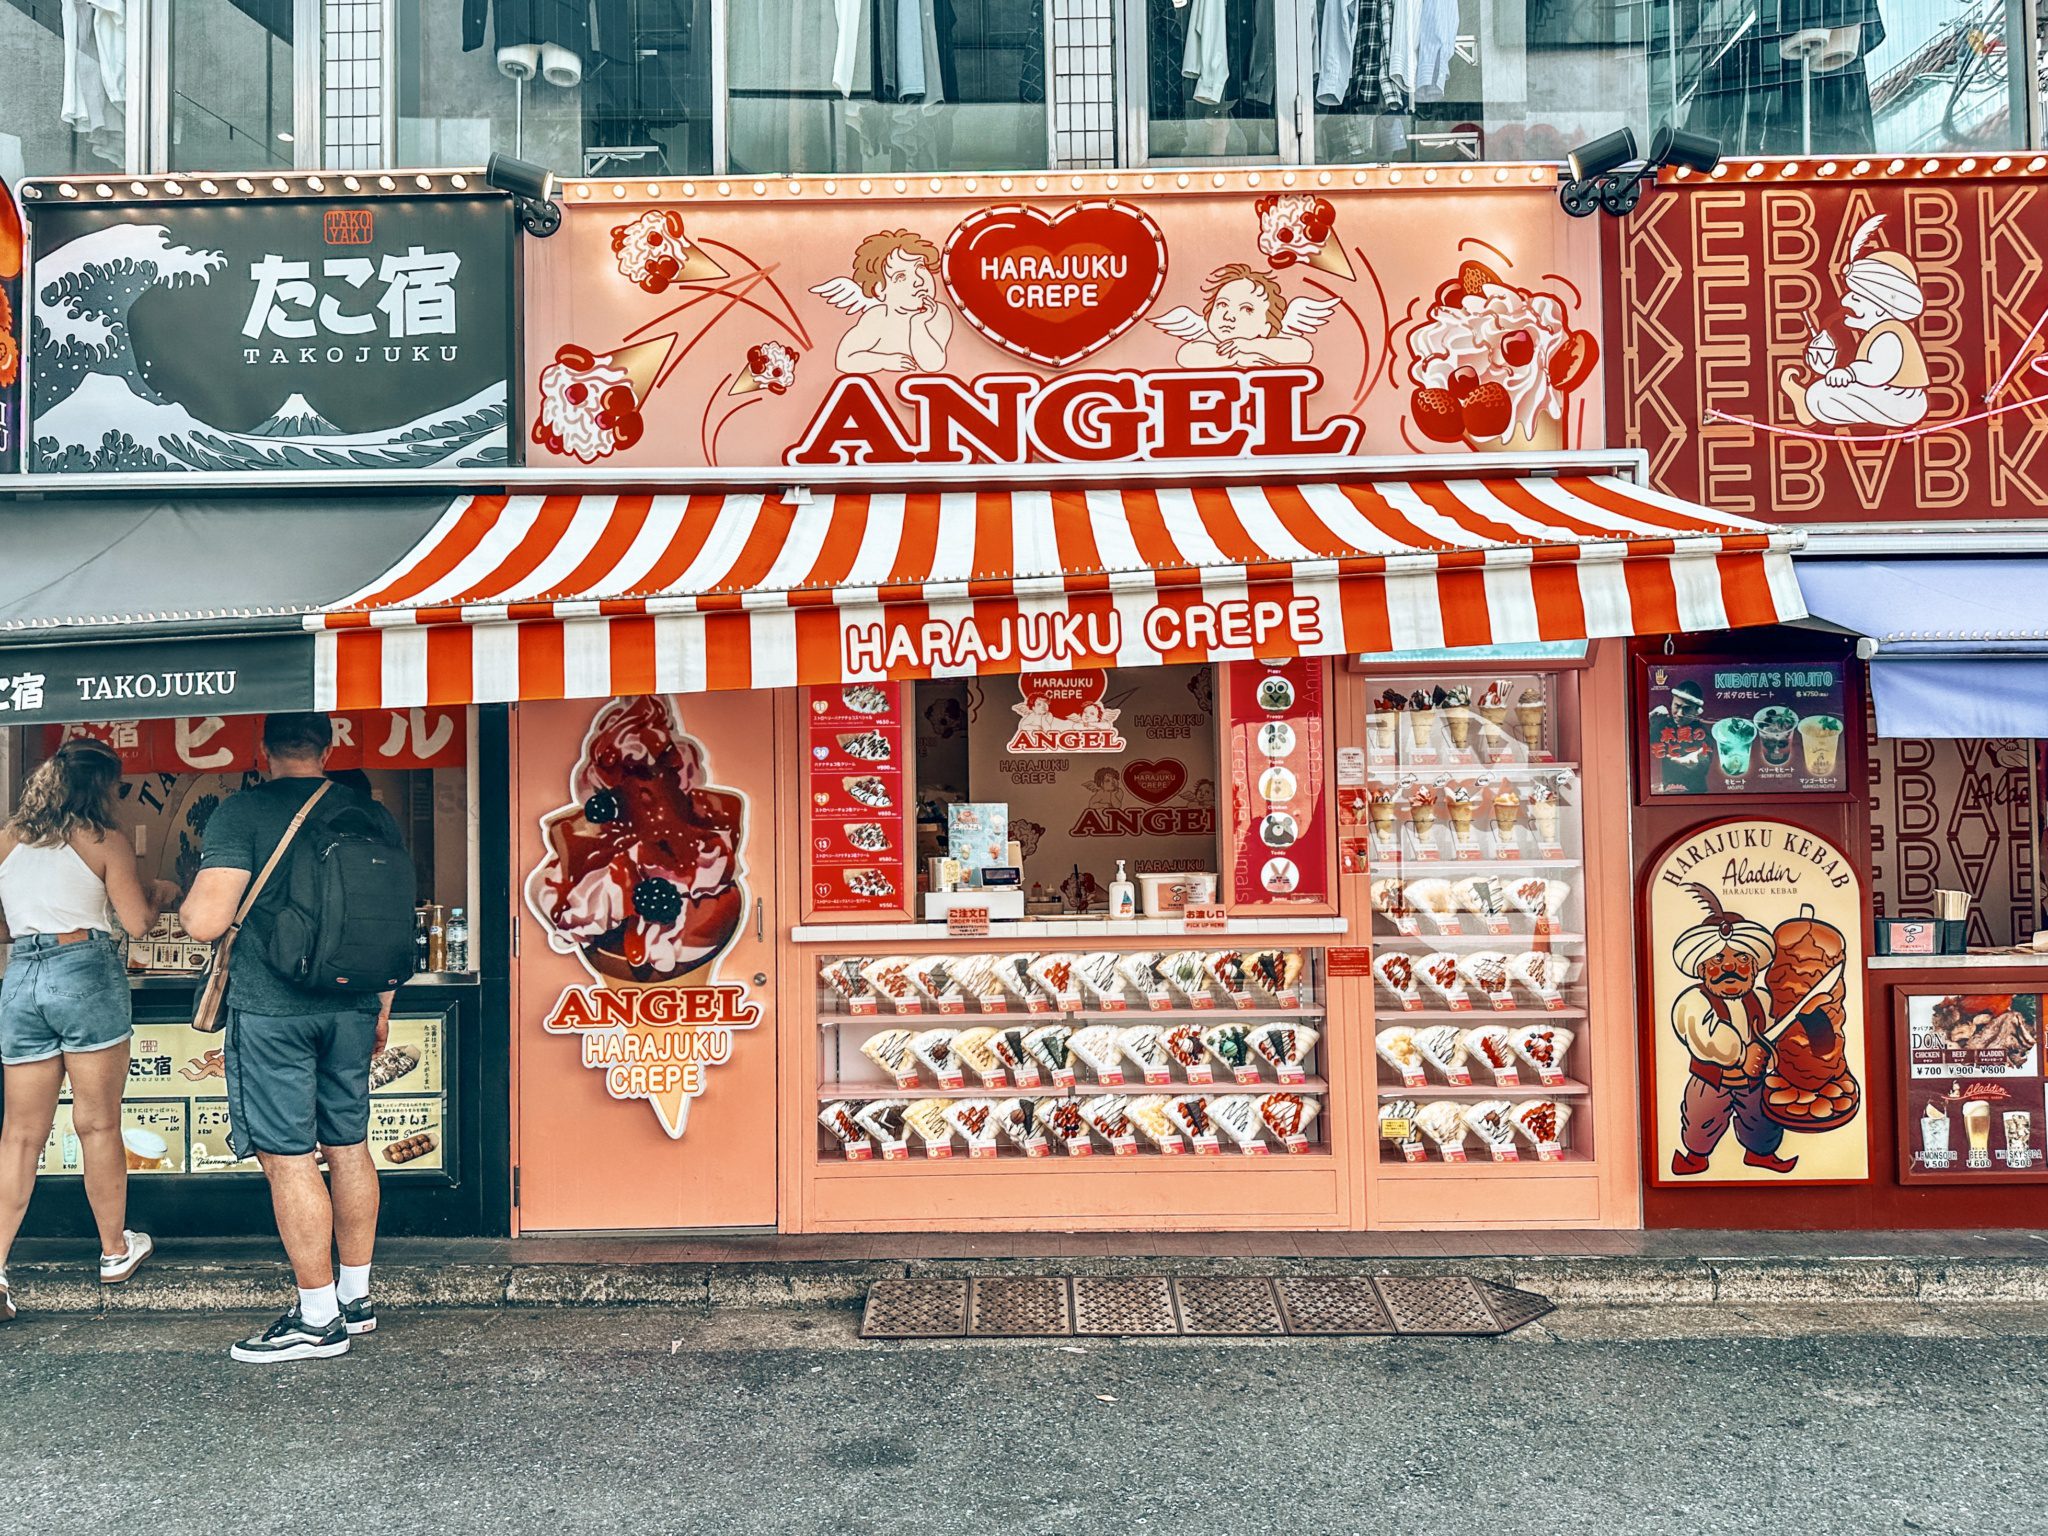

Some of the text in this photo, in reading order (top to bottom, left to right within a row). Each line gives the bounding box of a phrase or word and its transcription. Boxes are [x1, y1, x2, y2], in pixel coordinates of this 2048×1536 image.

[326, 211, 370, 229] TAKO
[328, 227, 370, 243] YAKI
[980, 254, 1128, 281] HARAJUKU
[242, 245, 462, 340] たこ宿
[1006, 282, 1099, 308] CREPE
[243, 345, 459, 364] TAKOJUKU
[784, 368, 1364, 465] ANGEL
[845, 596, 1323, 674] HARAJUKU CREPE
[77, 671, 237, 701] TAKOJUKU
[1033, 677, 1093, 688] HARAJUKU
[1714, 671, 1833, 689] KUBOTA'S MOJITO
[1046, 689, 1083, 700] CREPE
[1134, 714, 1205, 728] HARAJUKU
[1009, 731, 1124, 751] ANGEL
[1146, 727, 1191, 739] CREPE
[1000, 759, 1069, 772] HARAJUKU
[1011, 771, 1057, 784] CREPE
[1134, 774, 1176, 782] HARAJUKU
[1141, 781, 1168, 789] CREPE
[1134, 859, 1205, 873] HARAJUKU
[1662, 828, 1851, 890] HARAJUKU KEBAB
[1722, 857, 1802, 887] Aladdin
[1770, 887, 1798, 895] KEBAB
[949, 908, 988, 918] ご注文口
[1186, 909, 1225, 919] お渡し口
[548, 985, 760, 1029] ANGEL
[585, 1031, 728, 1064] HARAJUKU
[1912, 1033, 1945, 1050] DON
[1951, 1050, 1967, 1058] BEEF
[1979, 1050, 2005, 1058] ALADDIN
[1916, 1065, 2006, 1075] ¥700 ¥900 ¥800
[610, 1063, 700, 1095] CREPE
[1968, 1150, 1989, 1159] BEER
[1924, 1159, 2032, 1168] ¥500 ¥600 ¥500
